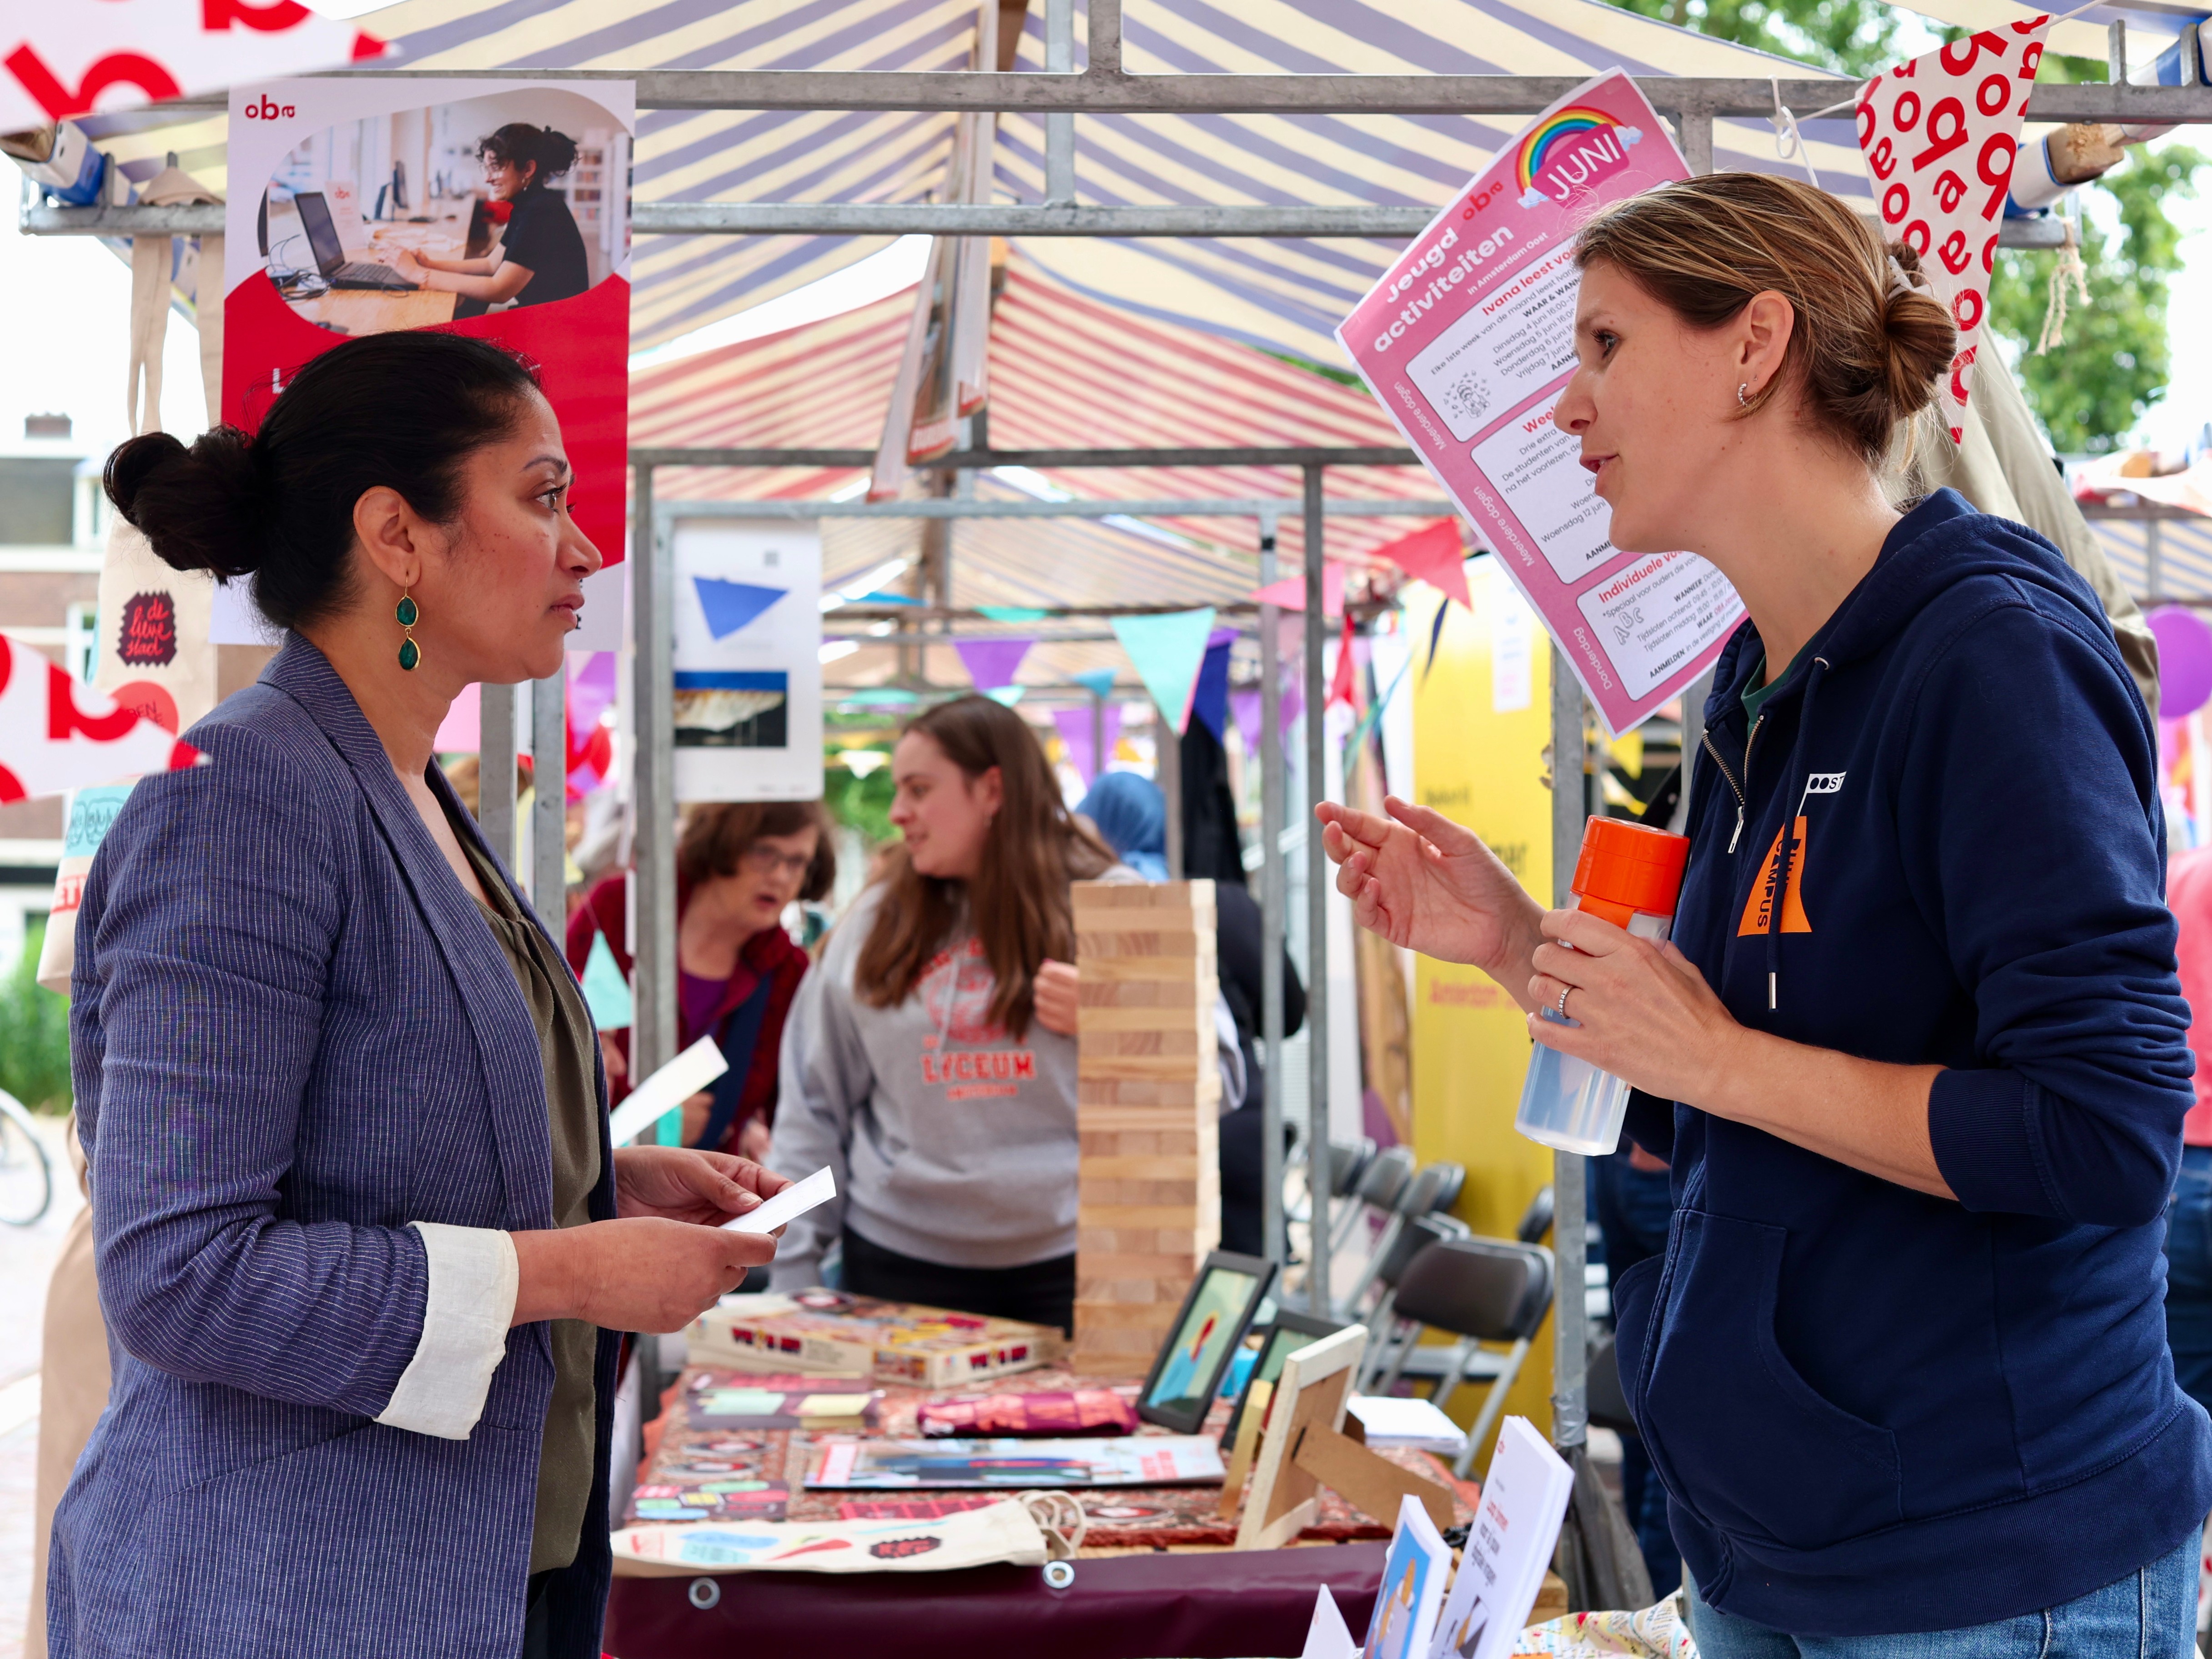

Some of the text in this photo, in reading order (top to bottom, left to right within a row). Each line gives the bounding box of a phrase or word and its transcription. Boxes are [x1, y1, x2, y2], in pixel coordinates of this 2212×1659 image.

[245, 94, 295, 120] oba
[1547, 133, 1621, 200] JUNI
[1463, 181, 1503, 220] oba
[1388, 226, 1459, 302] Jeugd
[1468, 232, 1548, 295] In Amsterdam Oost
[1375, 226, 1514, 352] activiteiten
[1483, 286, 1520, 315] Ivana
[1520, 261, 1554, 287] leest
[1523, 299, 1548, 317] WAAR
[1555, 278, 1581, 295] WANN
[1432, 362, 1445, 374] Elke
[1462, 335, 1479, 350] week
[1482, 322, 1496, 334] van
[1497, 314, 1507, 323] de
[1508, 292, 1536, 314] maand
[1536, 280, 1555, 294] leest
[1493, 329, 1526, 353] Dinsdag
[1532, 314, 1547, 328] juni
[1548, 297, 1576, 315] 16:00-17
[1494, 336, 1536, 366] Woensdag
[1542, 321, 1557, 335] juni
[1557, 306, 1575, 323] 16:00
[1501, 344, 1546, 376] Donderdag
[1552, 329, 1566, 343] juni
[1516, 358, 1546, 377] Vrijdag
[1551, 344, 1566, 358] juni
[1552, 352, 1575, 370] AANM
[1394, 382, 1446, 450] Meerdere dagen
[1523, 407, 1554, 433] Wee
[1502, 433, 1571, 481] De studenten van
[1519, 429, 1557, 455] Drie extra
[1506, 440, 1581, 493] na het voorlezen, de
[1571, 490, 1596, 510] Woens
[1474, 487, 1534, 567] Meerdere dagen
[1542, 515, 1584, 542] Woensdag
[1591, 500, 1606, 514] juni
[1585, 541, 1610, 560] AANME
[1599, 557, 1664, 603] Individuele
[1635, 584, 1653, 600] voor
[1653, 569, 1676, 591] ouders
[1673, 562, 1686, 575] die
[1703, 567, 1719, 582] Dond
[146, 597, 170, 621] de
[1637, 619, 1668, 642] Tijdsloten
[1644, 629, 1674, 653] Tijdsloten
[1685, 644, 1692, 652] in
[1691, 637, 1700, 647] de
[1573, 627, 1612, 690] Donderdag
[1810, 776, 1845, 789] OOST
